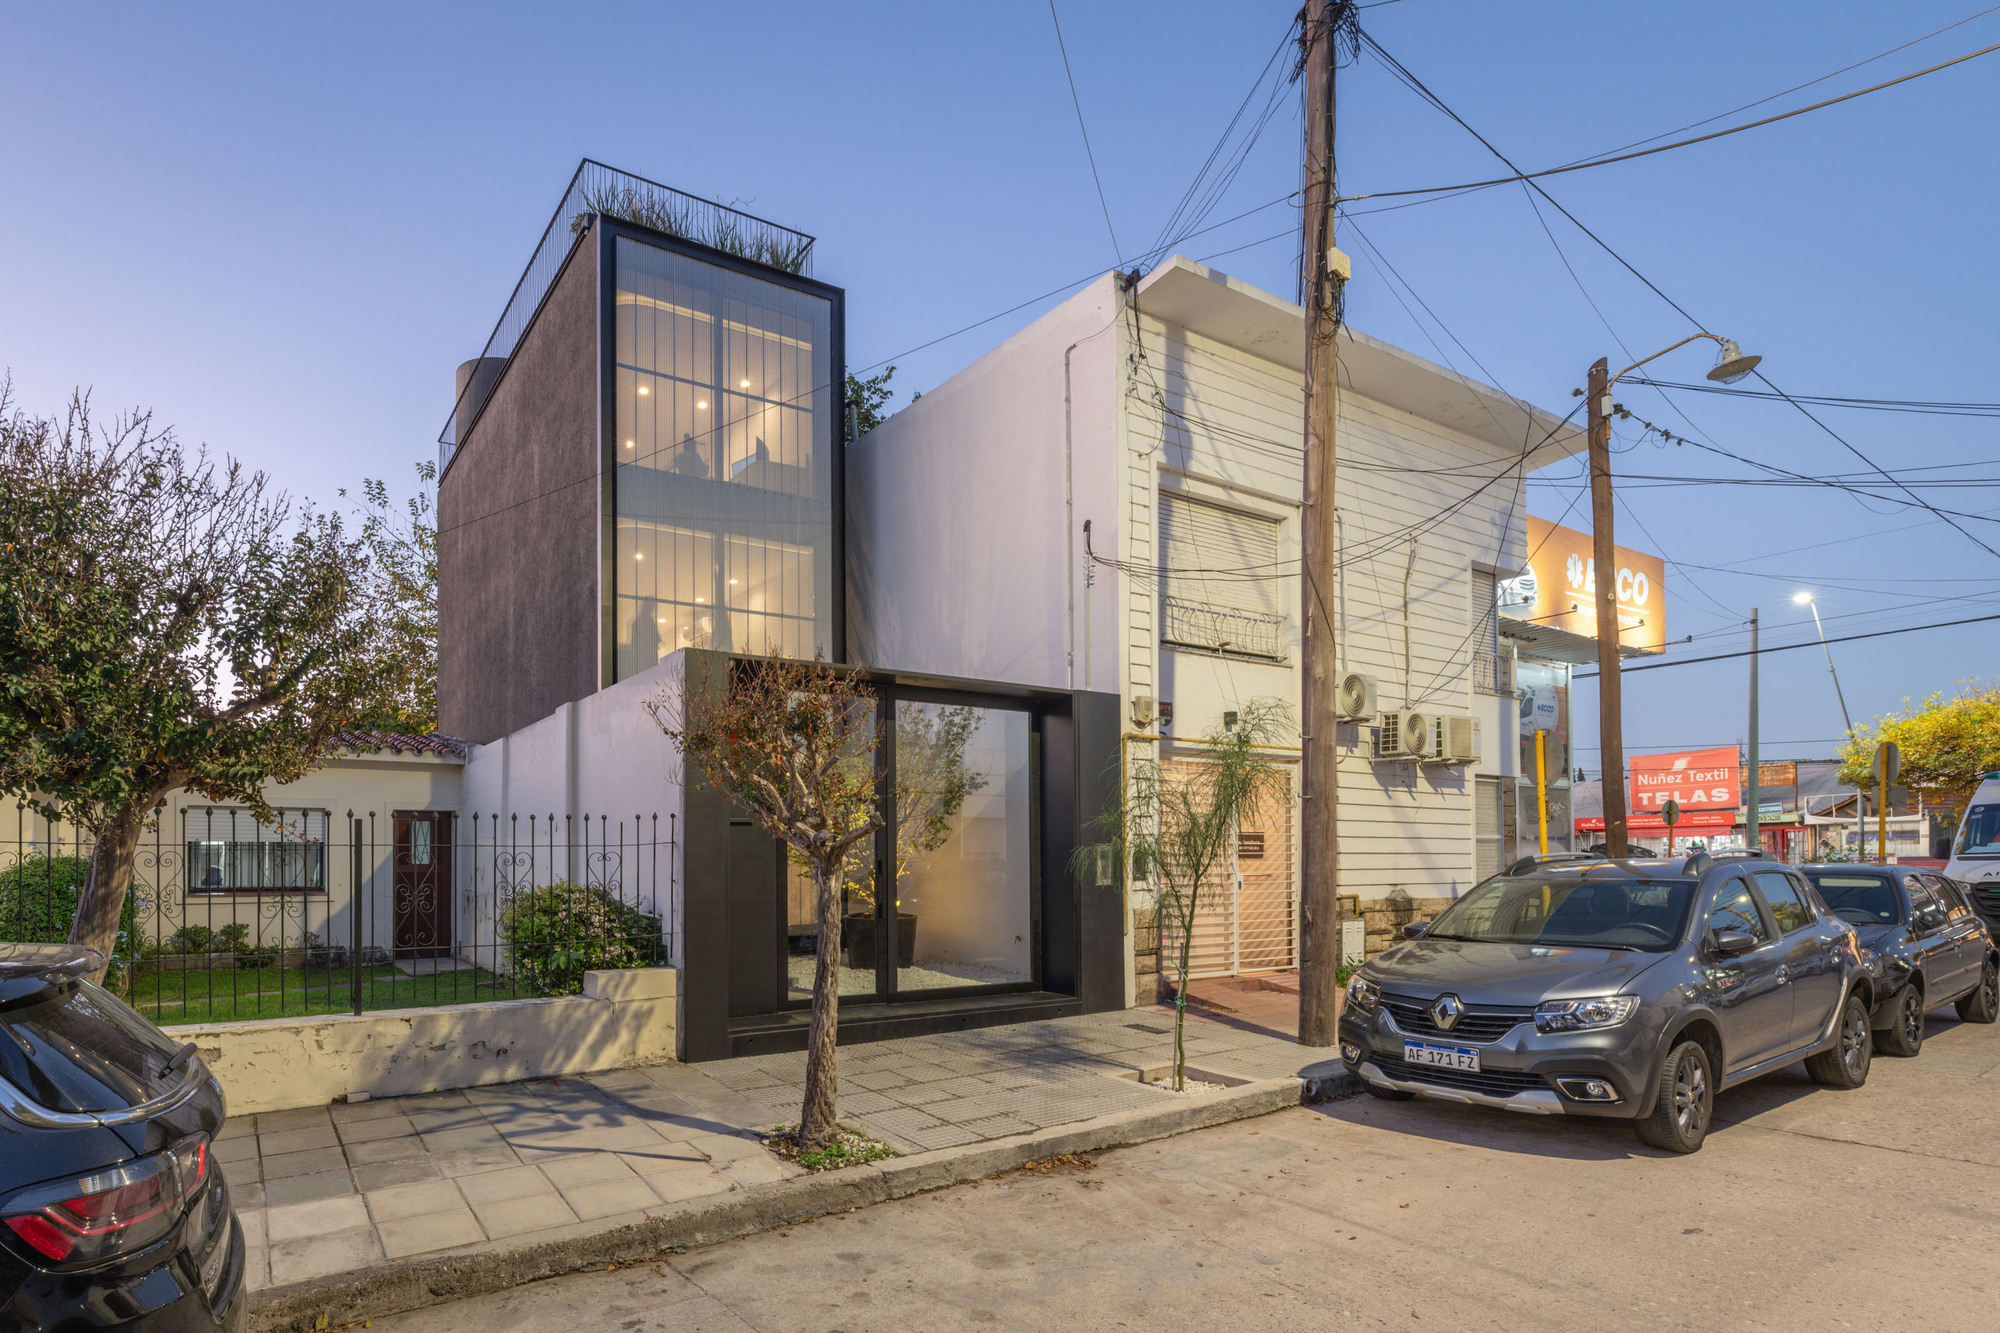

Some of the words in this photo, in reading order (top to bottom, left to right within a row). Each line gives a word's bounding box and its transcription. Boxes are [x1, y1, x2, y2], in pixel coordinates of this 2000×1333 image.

[1584, 558, 1649, 605] ECO
[1540, 704, 1555, 713] ECCO
[1638, 773, 1683, 785] Nuñez
[1687, 768, 1728, 782] Textil
[1638, 787, 1730, 805] TELAS
[1408, 1048, 1423, 1061] AF
[1428, 1051, 1454, 1066] 171
[1458, 1055, 1475, 1069] FZ
